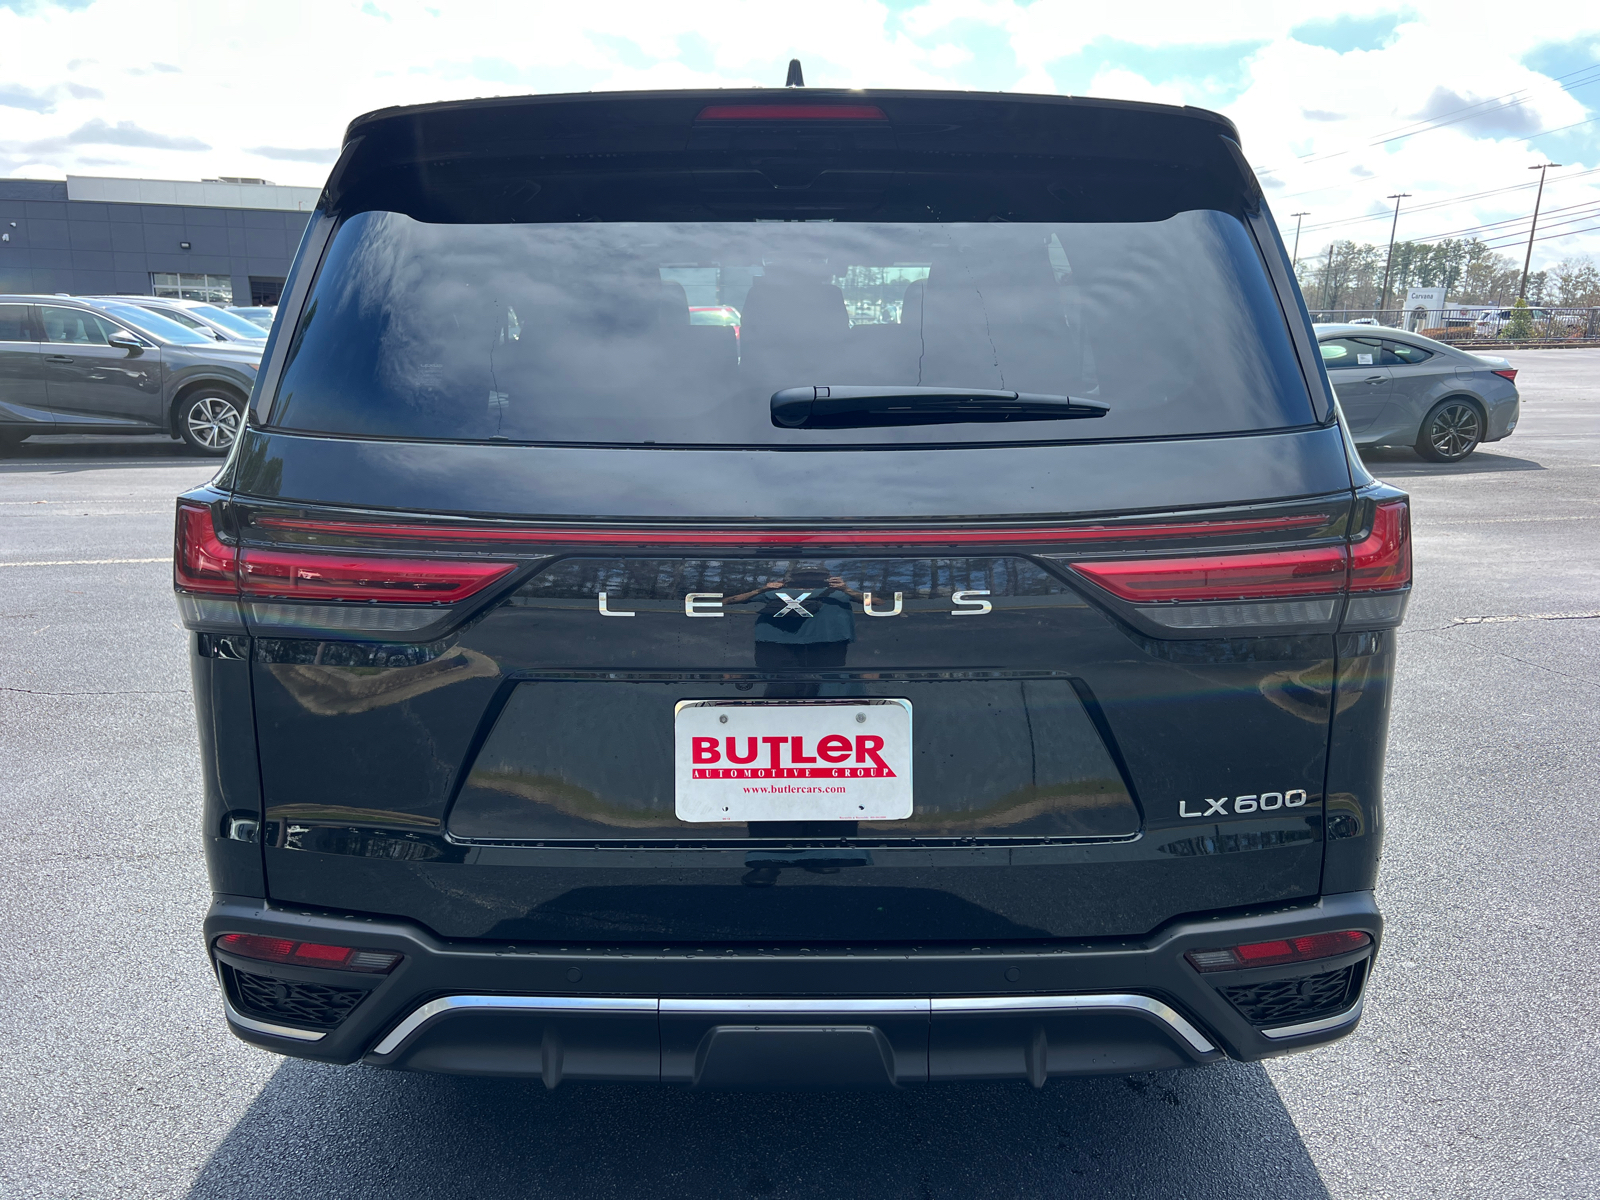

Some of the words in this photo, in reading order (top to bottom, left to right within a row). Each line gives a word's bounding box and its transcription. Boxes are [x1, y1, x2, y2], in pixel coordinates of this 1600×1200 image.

[1411, 292, 1434, 300] Carvana
[598, 589, 993, 618] LEXUS
[693, 768, 812, 778] AUTOMOTIVE
[832, 768, 890, 778] GROUP
[743, 784, 846, 794] www.butlercars.com
